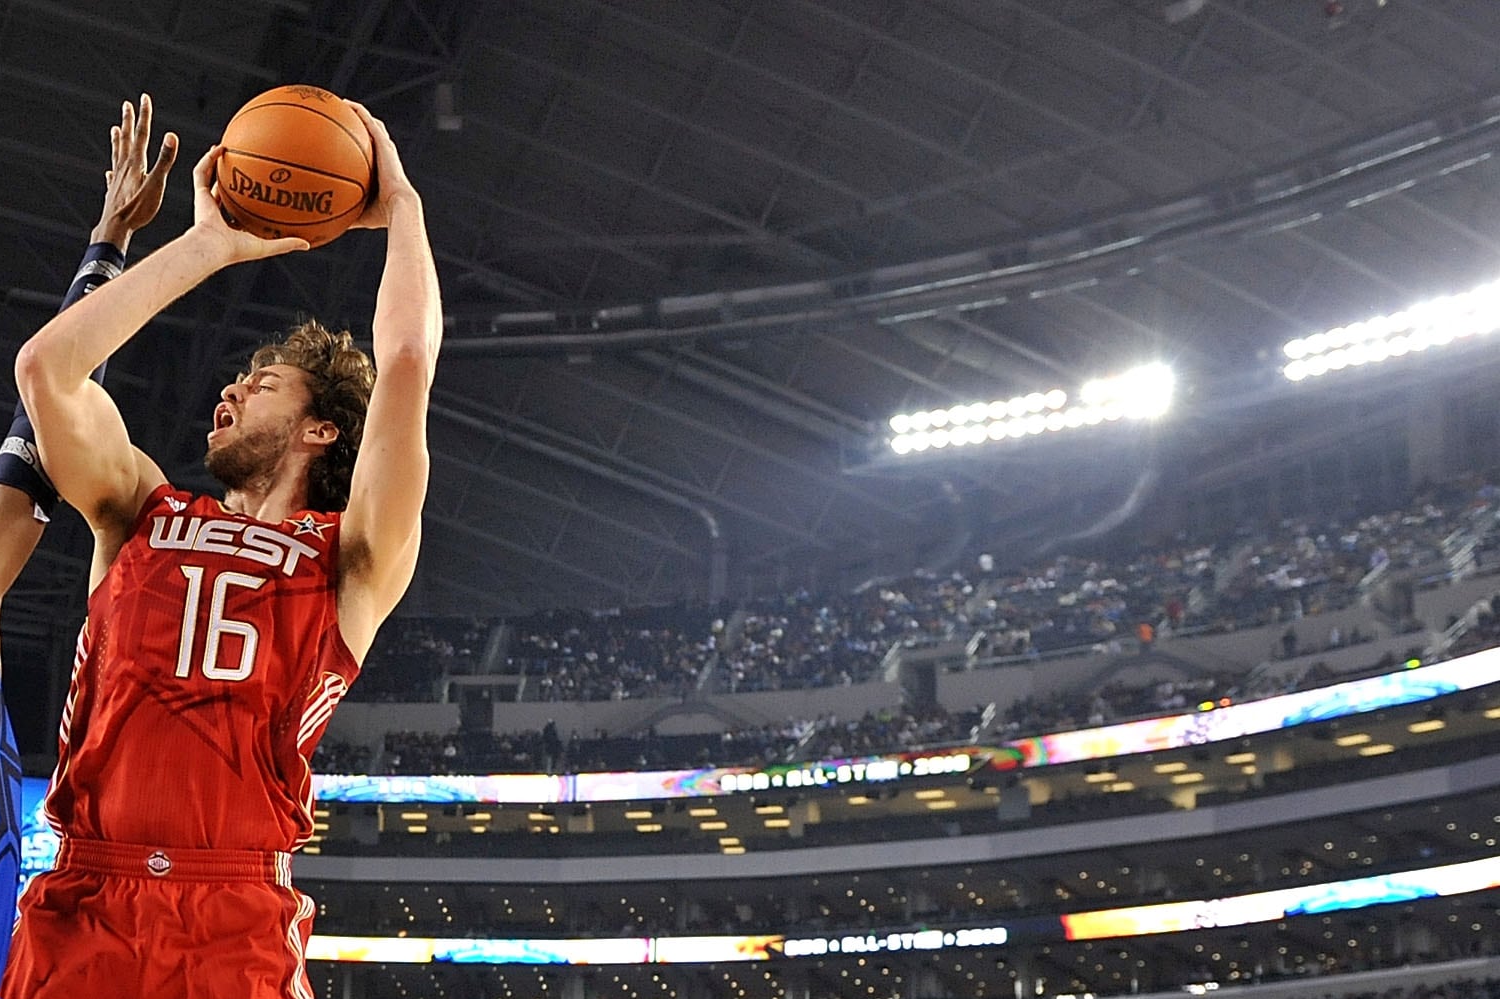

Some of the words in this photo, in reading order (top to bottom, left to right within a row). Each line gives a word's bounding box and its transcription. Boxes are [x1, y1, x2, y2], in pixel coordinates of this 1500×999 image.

[229, 166, 333, 215] SPALDING
[149, 515, 320, 577] WEST
[175, 565, 267, 681] 16
